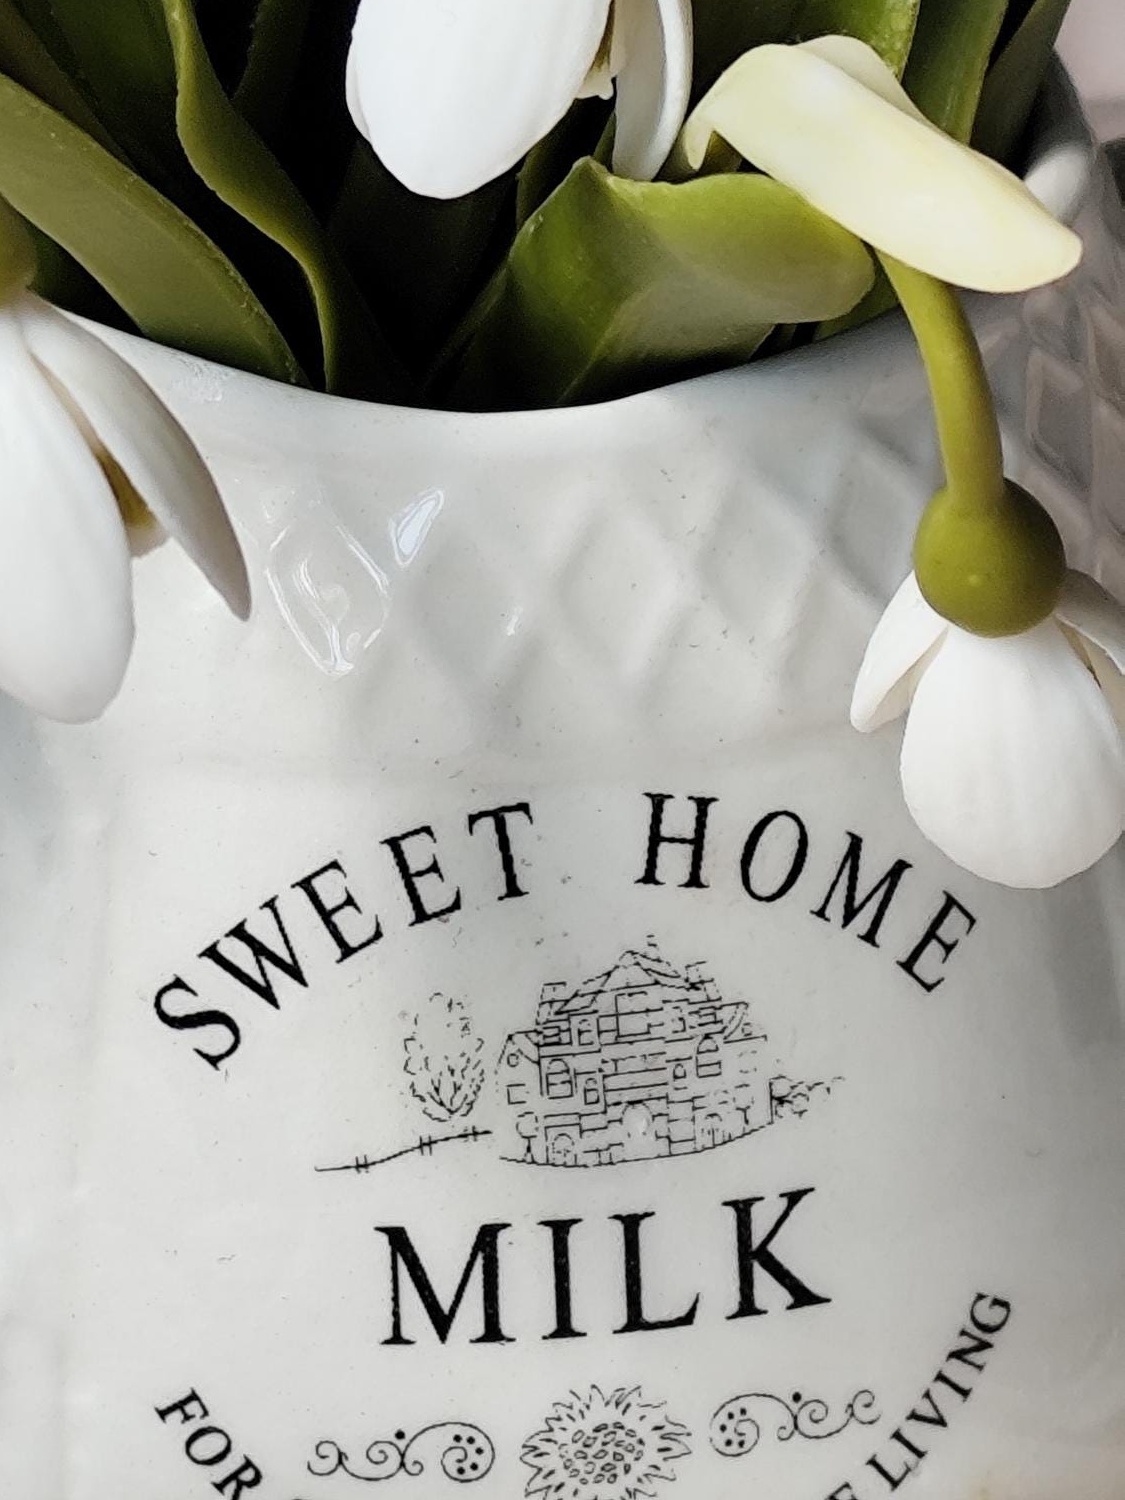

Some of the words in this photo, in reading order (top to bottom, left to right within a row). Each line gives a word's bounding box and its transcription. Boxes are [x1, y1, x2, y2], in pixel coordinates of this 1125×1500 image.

[152, 801, 535, 1072] SWEET
[634, 791, 978, 993] HOME
[373, 1186, 833, 1346] MILK
[153, 1387, 264, 1500] FOR
[865, 1292, 1012, 1493] LIVING
